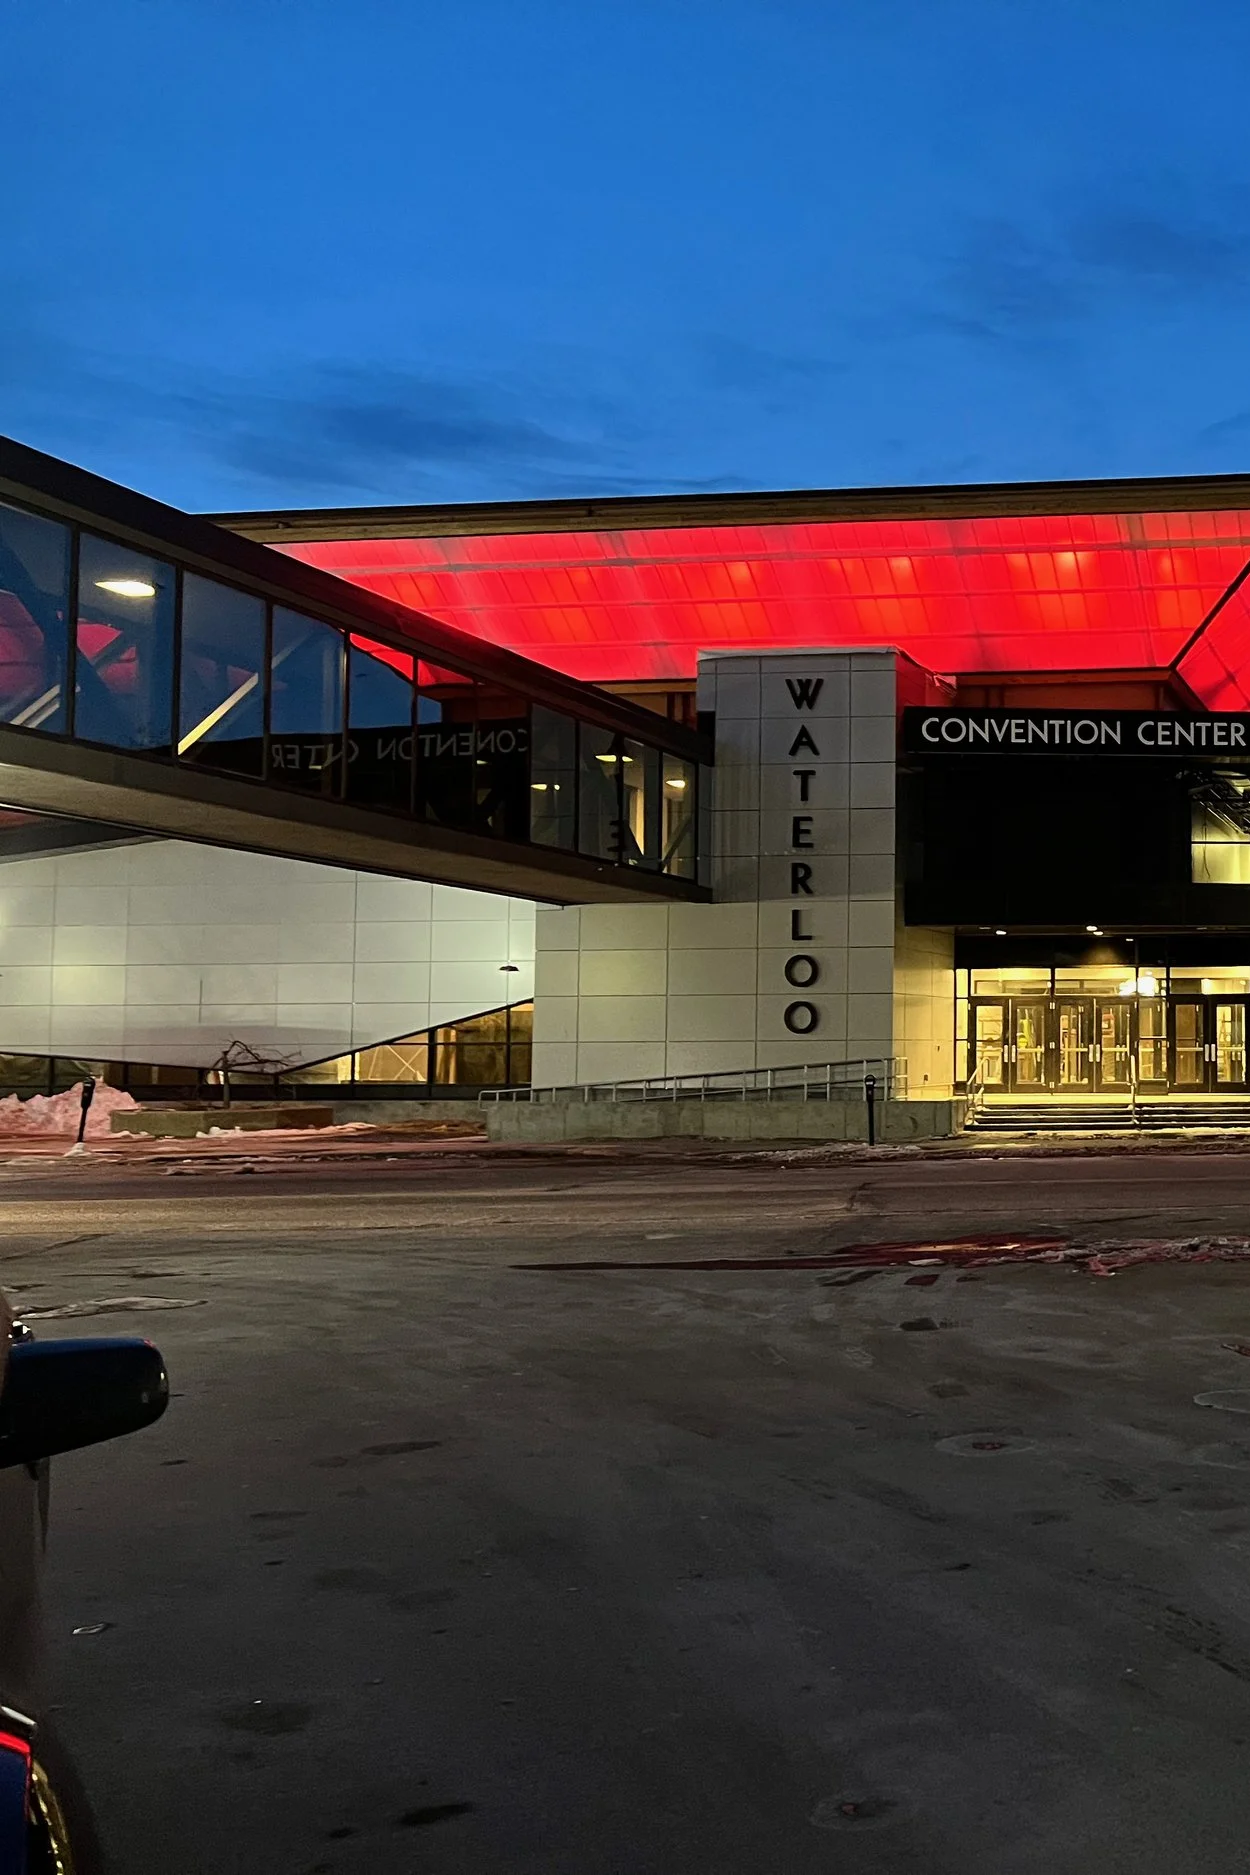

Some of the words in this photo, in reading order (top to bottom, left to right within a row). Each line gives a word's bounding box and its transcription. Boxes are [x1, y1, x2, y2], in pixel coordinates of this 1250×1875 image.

[921, 717, 1121, 745] CONVENTION
[1137, 720, 1246, 746] CENTER
[784, 678, 824, 1035] WATERLOO
